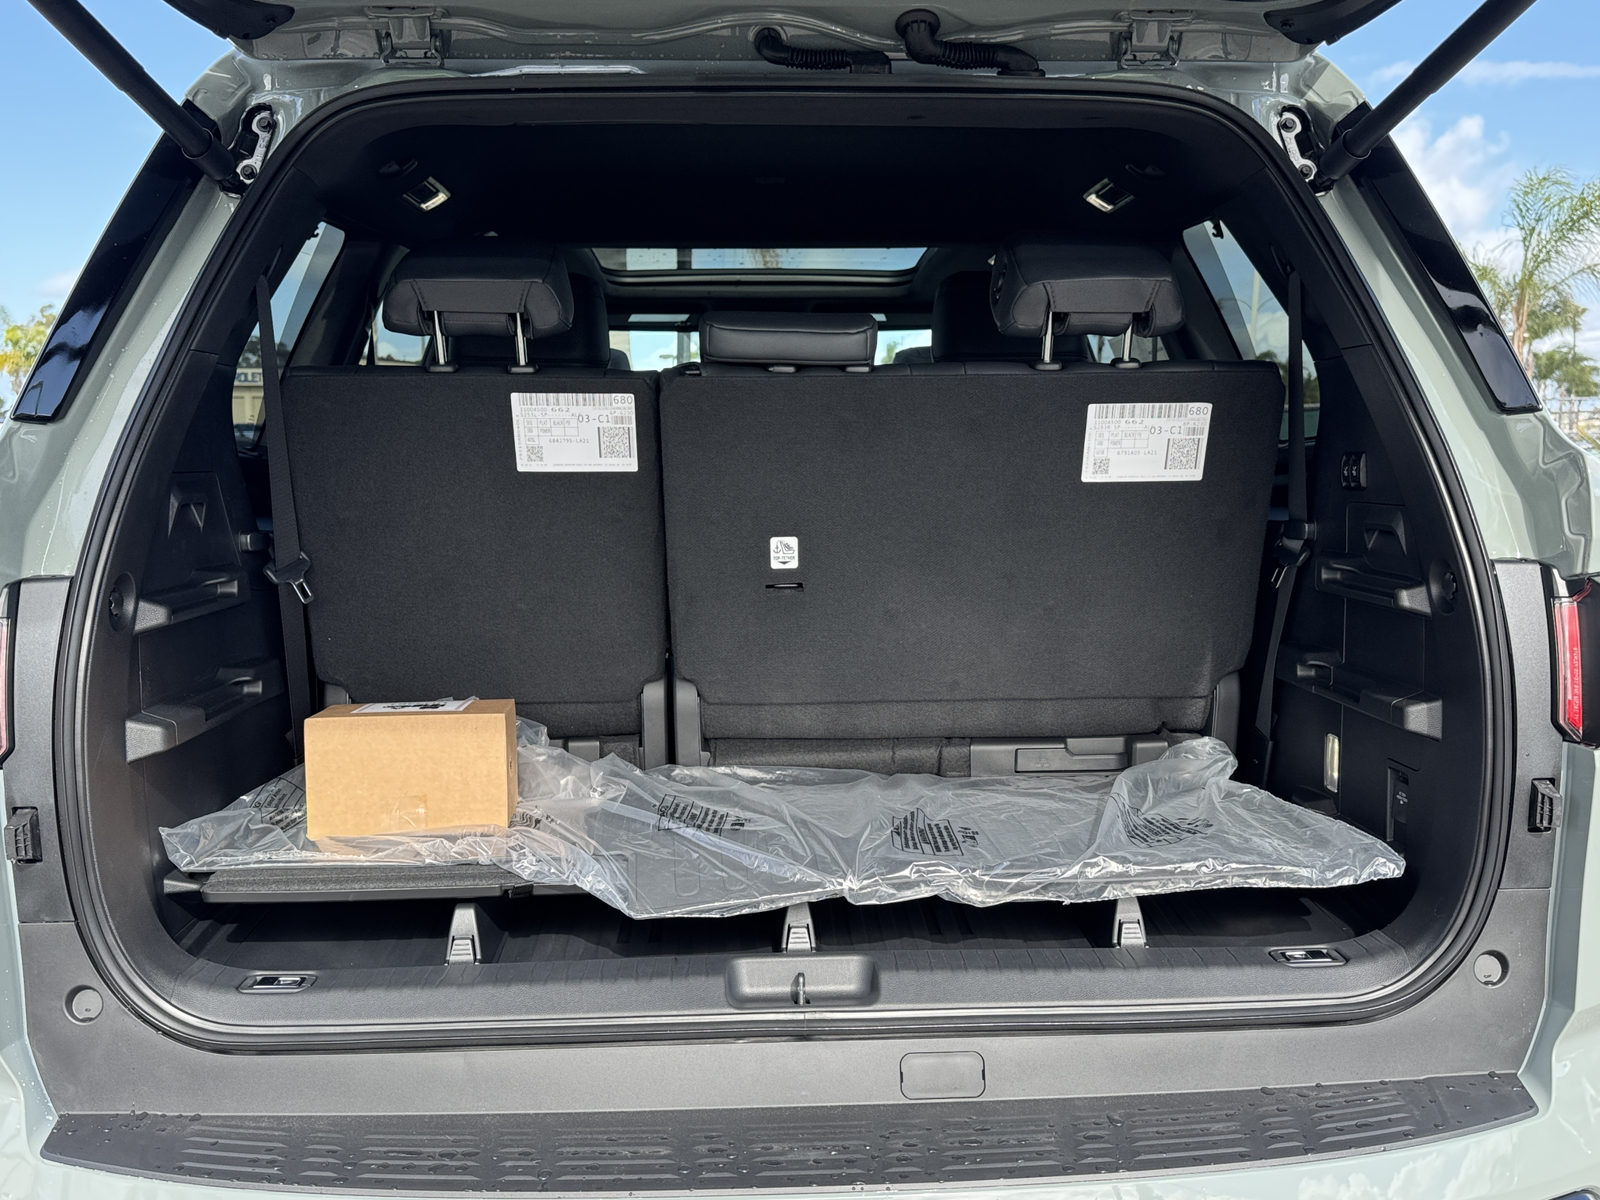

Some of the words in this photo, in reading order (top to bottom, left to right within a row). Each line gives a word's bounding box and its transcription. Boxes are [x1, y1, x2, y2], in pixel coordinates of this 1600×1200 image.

[613, 395, 633, 404] 680
[1189, 406, 1209, 416] 680
[577, 414, 611, 424] 03-C1
[1149, 426, 1183, 435] 03-C1
